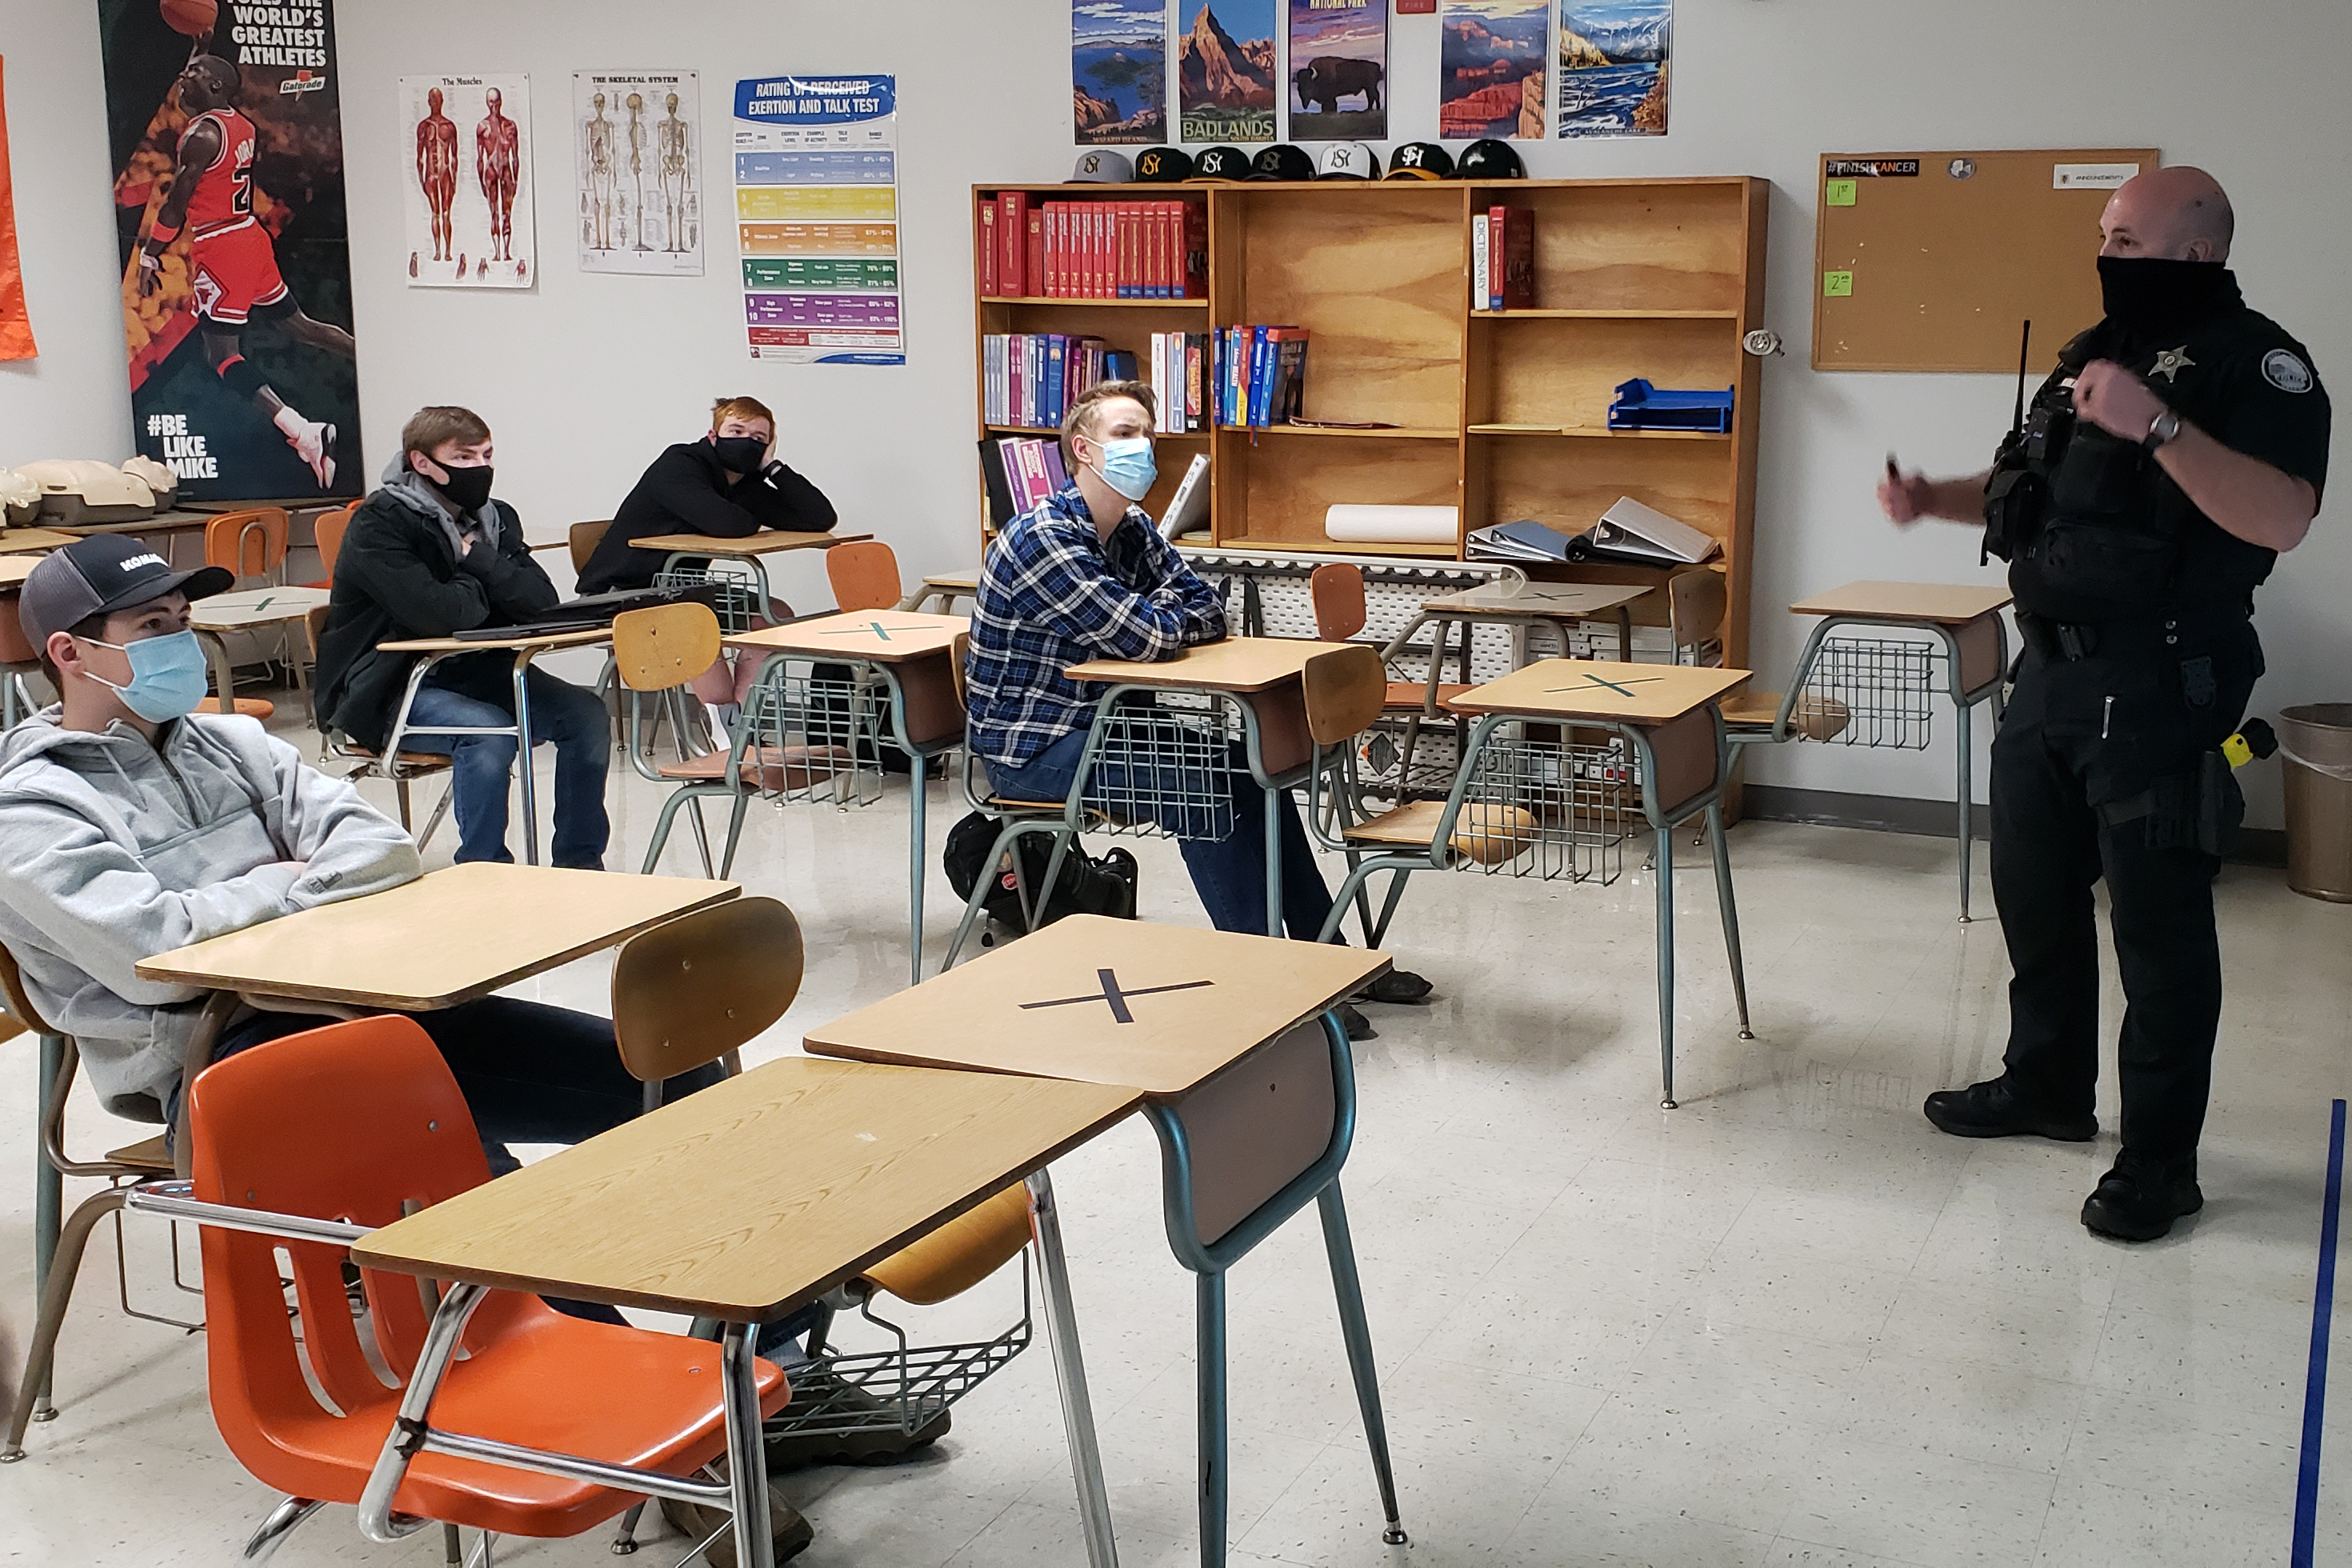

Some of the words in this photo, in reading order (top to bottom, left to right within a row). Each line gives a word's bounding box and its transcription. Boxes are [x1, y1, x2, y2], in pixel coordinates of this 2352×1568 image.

[1310, 0, 1346, 10] NATIONAL
[1348, 0, 1367, 8] PARK
[233, 6, 323, 26] WORLD'S
[232, 26, 325, 46] GREATEST
[238, 46, 326, 66] ATHLETES
[282, 80, 322, 91] Gatorade
[442, 78, 454, 86] The
[456, 77, 482, 86] Muscles
[756, 82, 790, 98] RATING
[794, 82, 805, 96] OF
[810, 80, 870, 95] PERCEIVED
[749, 100, 796, 115] EXERTION
[799, 99, 821, 114] AND
[824, 99, 850, 114] TALK
[853, 98, 879, 113] TEST
[1183, 121, 1274, 138] BADLANDS
[741, 157, 745, 165] 1
[1827, 162, 1916, 173] #FINISHCANCER
[740, 170, 746, 178] 2
[743, 229, 749, 237] 5
[1477, 222, 1486, 291] DICTIONARY
[746, 263, 751, 273] 7
[749, 298, 754, 307] 9
[749, 312, 758, 320] 10
[147, 414, 188, 436] #BE
[163, 436, 207, 458] LIKE
[166, 457, 218, 478] MIKE
